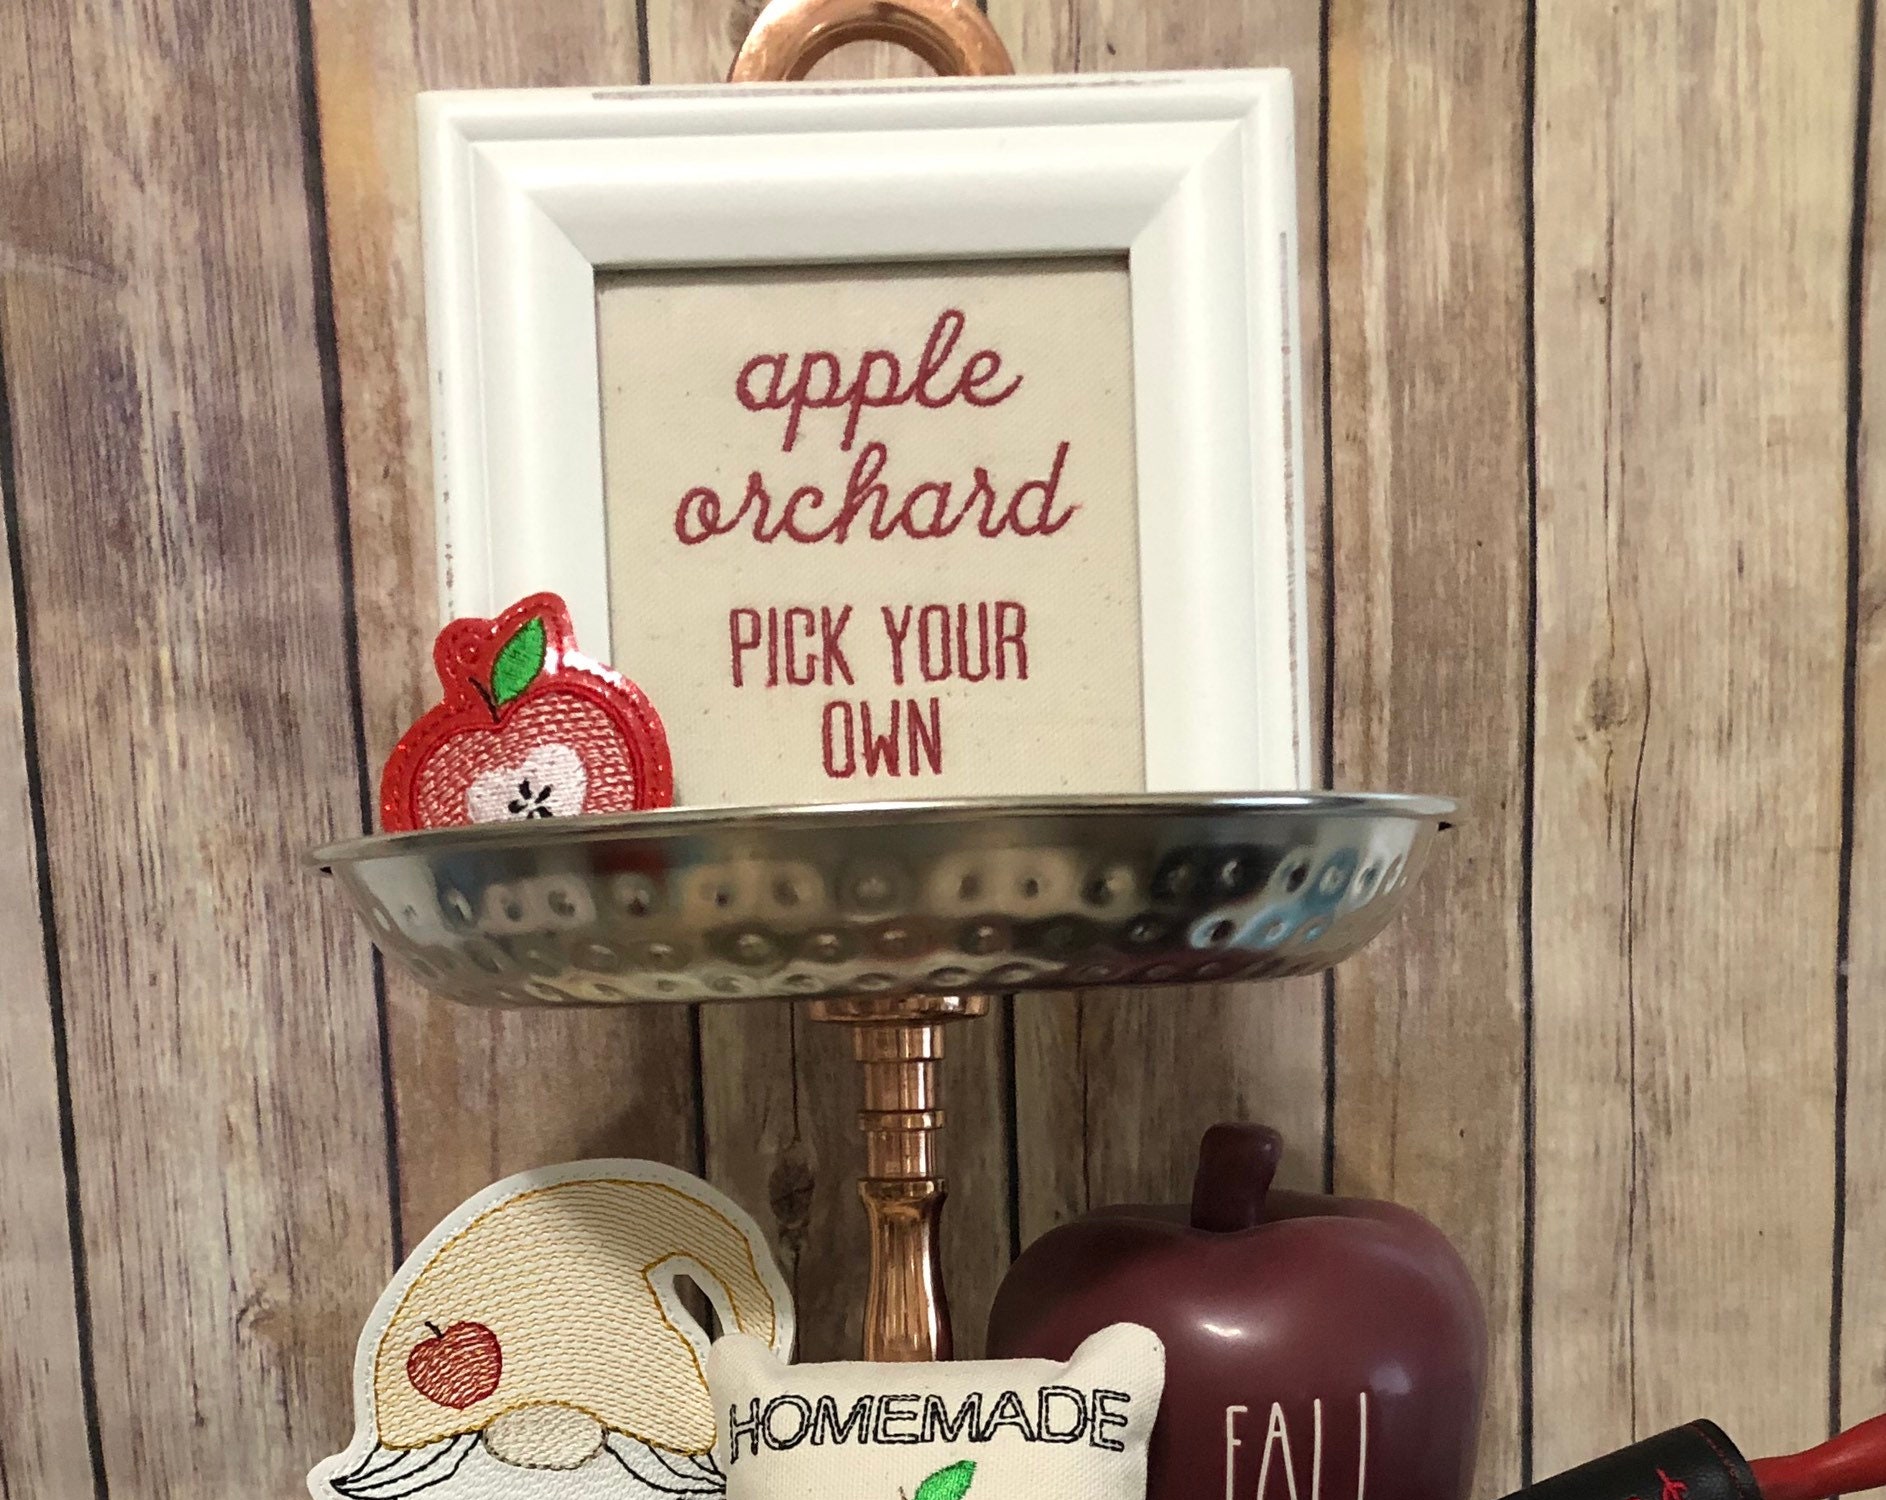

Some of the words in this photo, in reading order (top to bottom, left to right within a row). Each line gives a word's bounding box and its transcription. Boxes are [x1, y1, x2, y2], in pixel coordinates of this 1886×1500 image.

[735, 307, 1024, 452] apple
[673, 440, 1083, 545] orchard
[729, 603, 855, 688] PICK
[881, 600, 1029, 685] YOUR
[821, 697, 944, 779] OWN
[728, 1386, 1130, 1463] HOMEMADE
